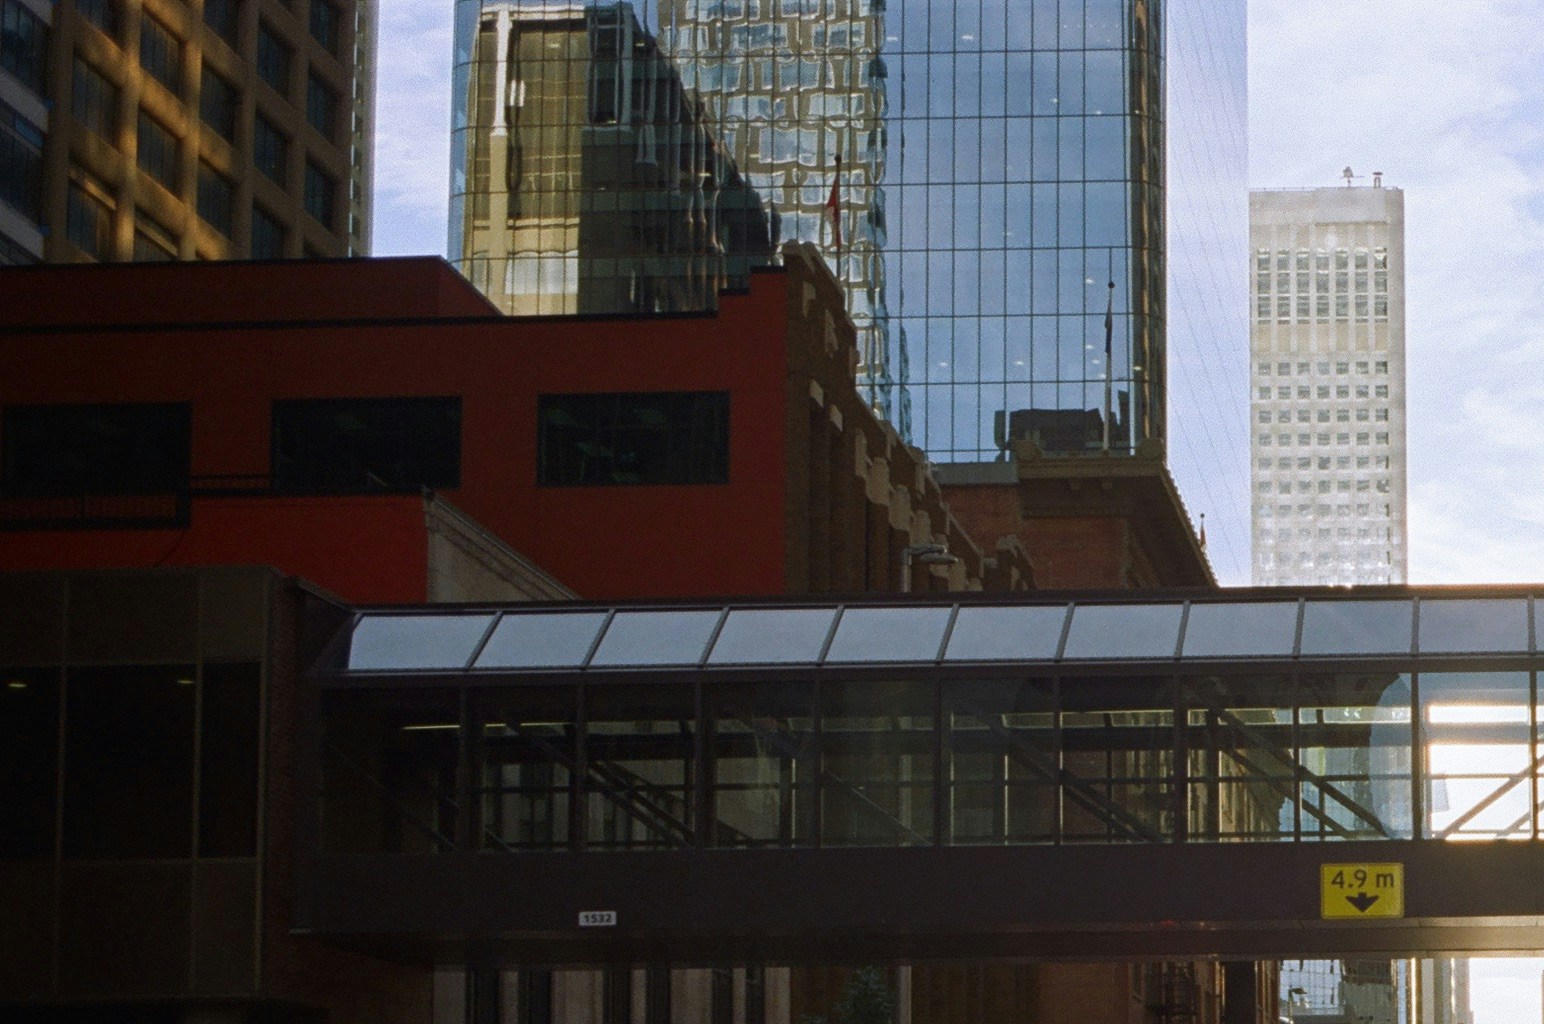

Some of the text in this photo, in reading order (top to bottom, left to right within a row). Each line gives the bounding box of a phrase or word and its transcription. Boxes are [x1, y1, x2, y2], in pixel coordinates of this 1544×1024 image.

[1331, 869, 1394, 889] 4.9 m
[583, 913, 613, 924] 1532
